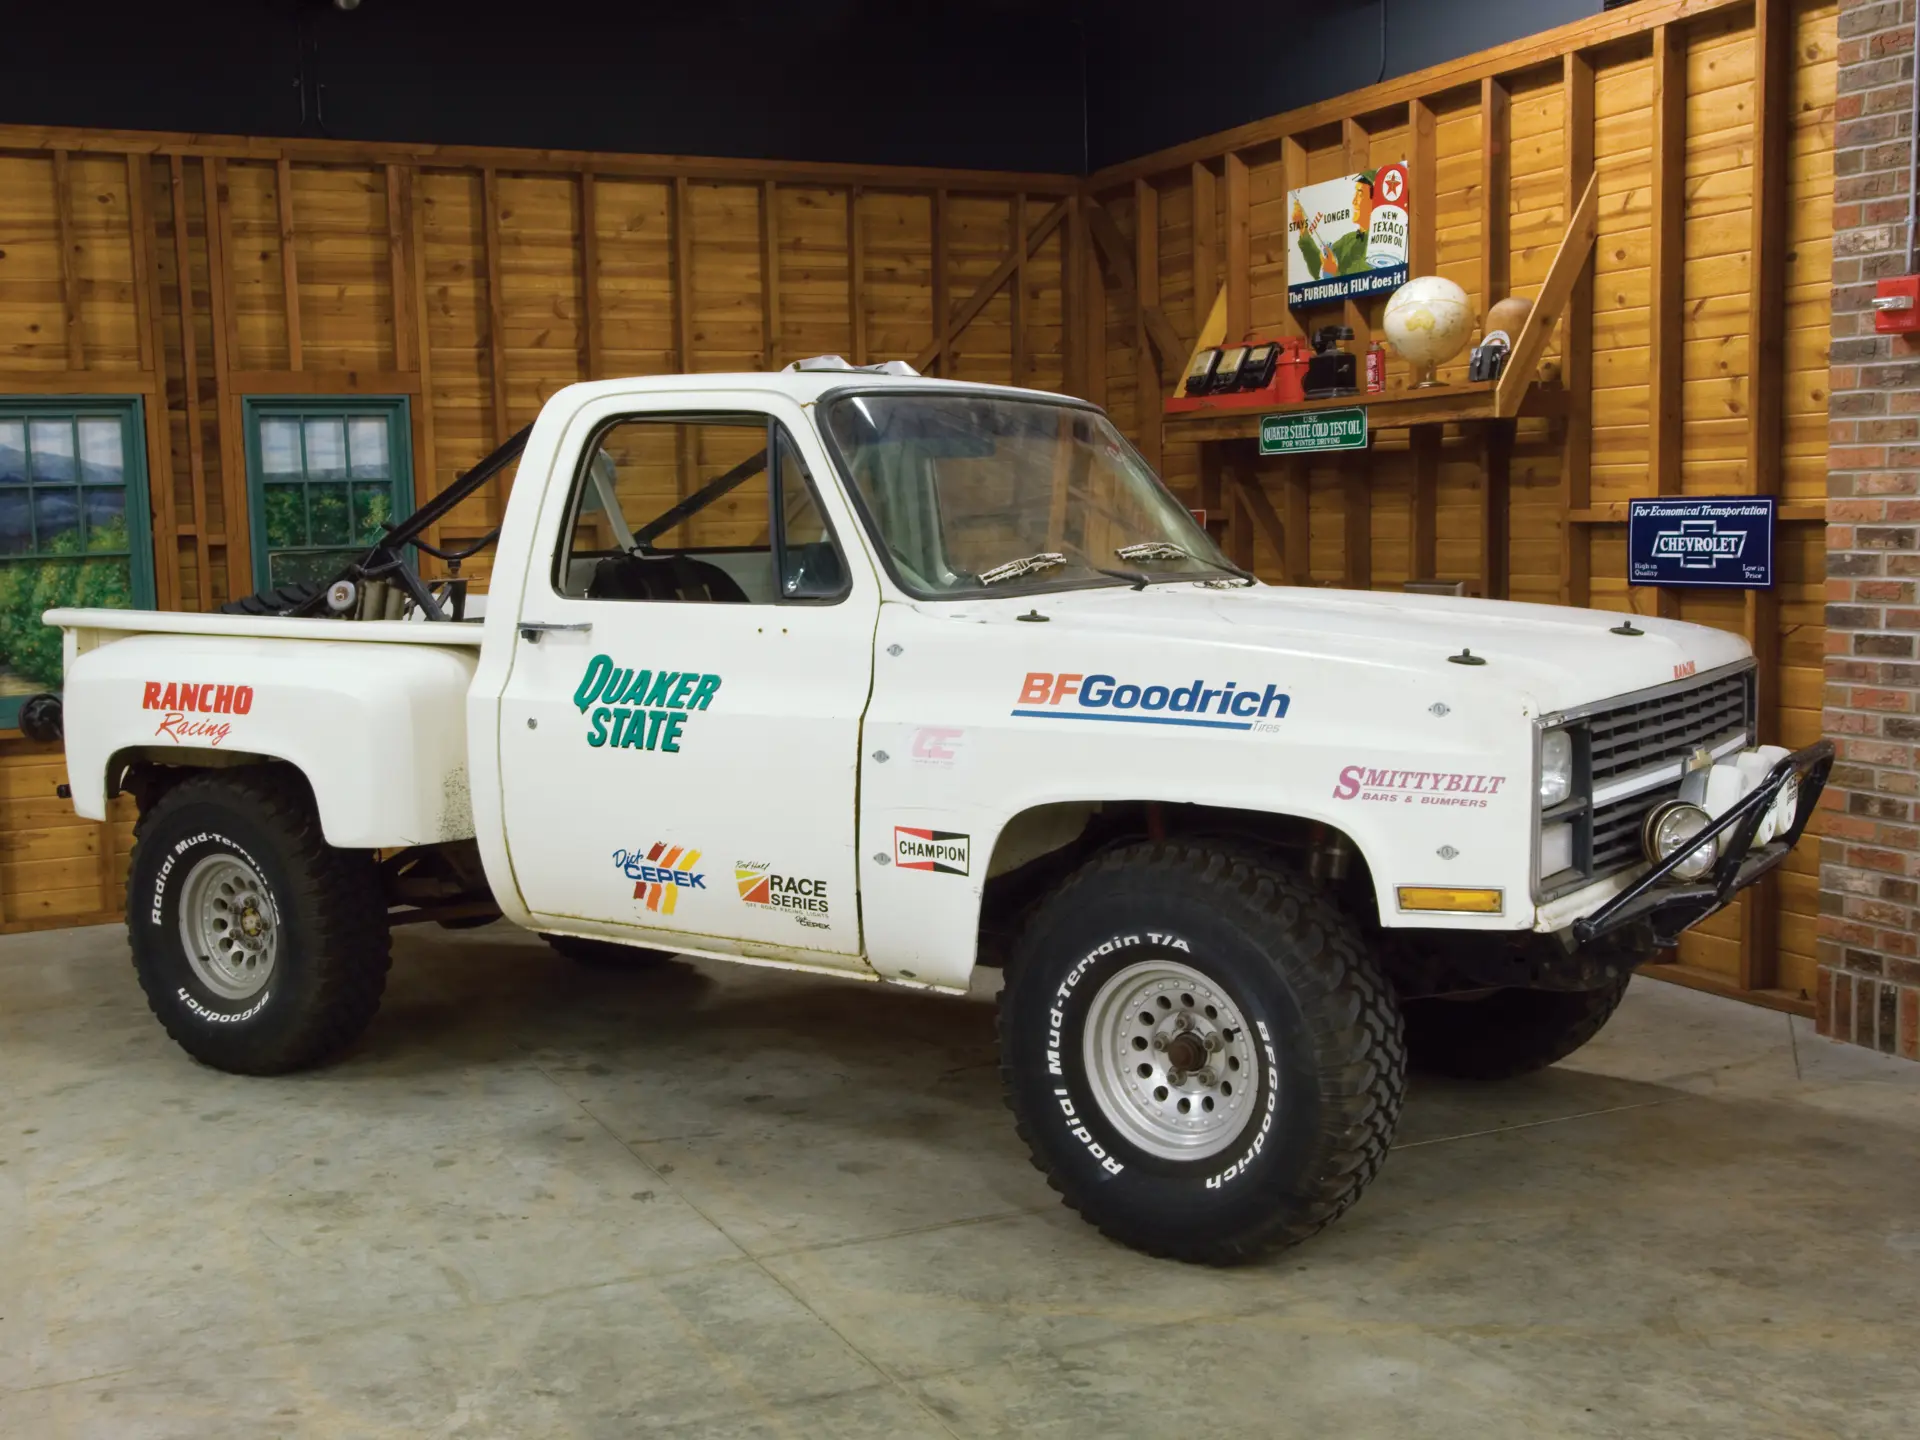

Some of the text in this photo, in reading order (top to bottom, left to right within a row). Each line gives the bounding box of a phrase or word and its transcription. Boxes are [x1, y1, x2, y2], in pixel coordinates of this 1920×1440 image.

[1289, 219, 1309, 232] STAYS
[1309, 211, 1323, 234] FULL
[1324, 209, 1350, 224] LONGER
[1382, 211, 1398, 220] NEW
[1373, 223, 1404, 237] TEXACO
[1370, 235, 1403, 248] MOTOR OIL
[1289, 292, 1303, 304] The
[1372, 275, 1392, 288] does
[1303, 415, 1319, 423] USE
[1263, 419, 1362, 443] QUAKER STATE COLD TEST OIL
[1281, 437, 1340, 448] FOR WINTER DRIVING
[1633, 505, 1768, 518] For Economical Transportation
[1659, 536, 1738, 552] CHEVROLET
[1634, 562, 1649, 571] High
[1634, 569, 1658, 578] Quality
[1742, 563, 1757, 572] Low
[1744, 570, 1762, 579] Price
[573, 654, 722, 715] QUAKER
[142, 681, 254, 715] RANCHO
[1017, 672, 1291, 719] BFGoodrich
[155, 712, 232, 746] Racing
[587, 707, 689, 753] STATE
[1252, 719, 1282, 734] Tires
[1332, 765, 1506, 801] SMITTYBILT
[1361, 792, 1488, 809] BARS & BUMPERS
[612, 848, 645, 868] Dick
[899, 840, 966, 863] CHAMPION
[624, 863, 707, 890] CEPEK
[770, 874, 828, 898] RACE
[152, 854, 176, 925] Radial
[771, 893, 829, 913] SERIES
[177, 987, 269, 1022] BFGoodrich
[1046, 932, 1190, 1177] Radial Mud-Terrain T/A
[1205, 1020, 1278, 1190] BFGoodrich
